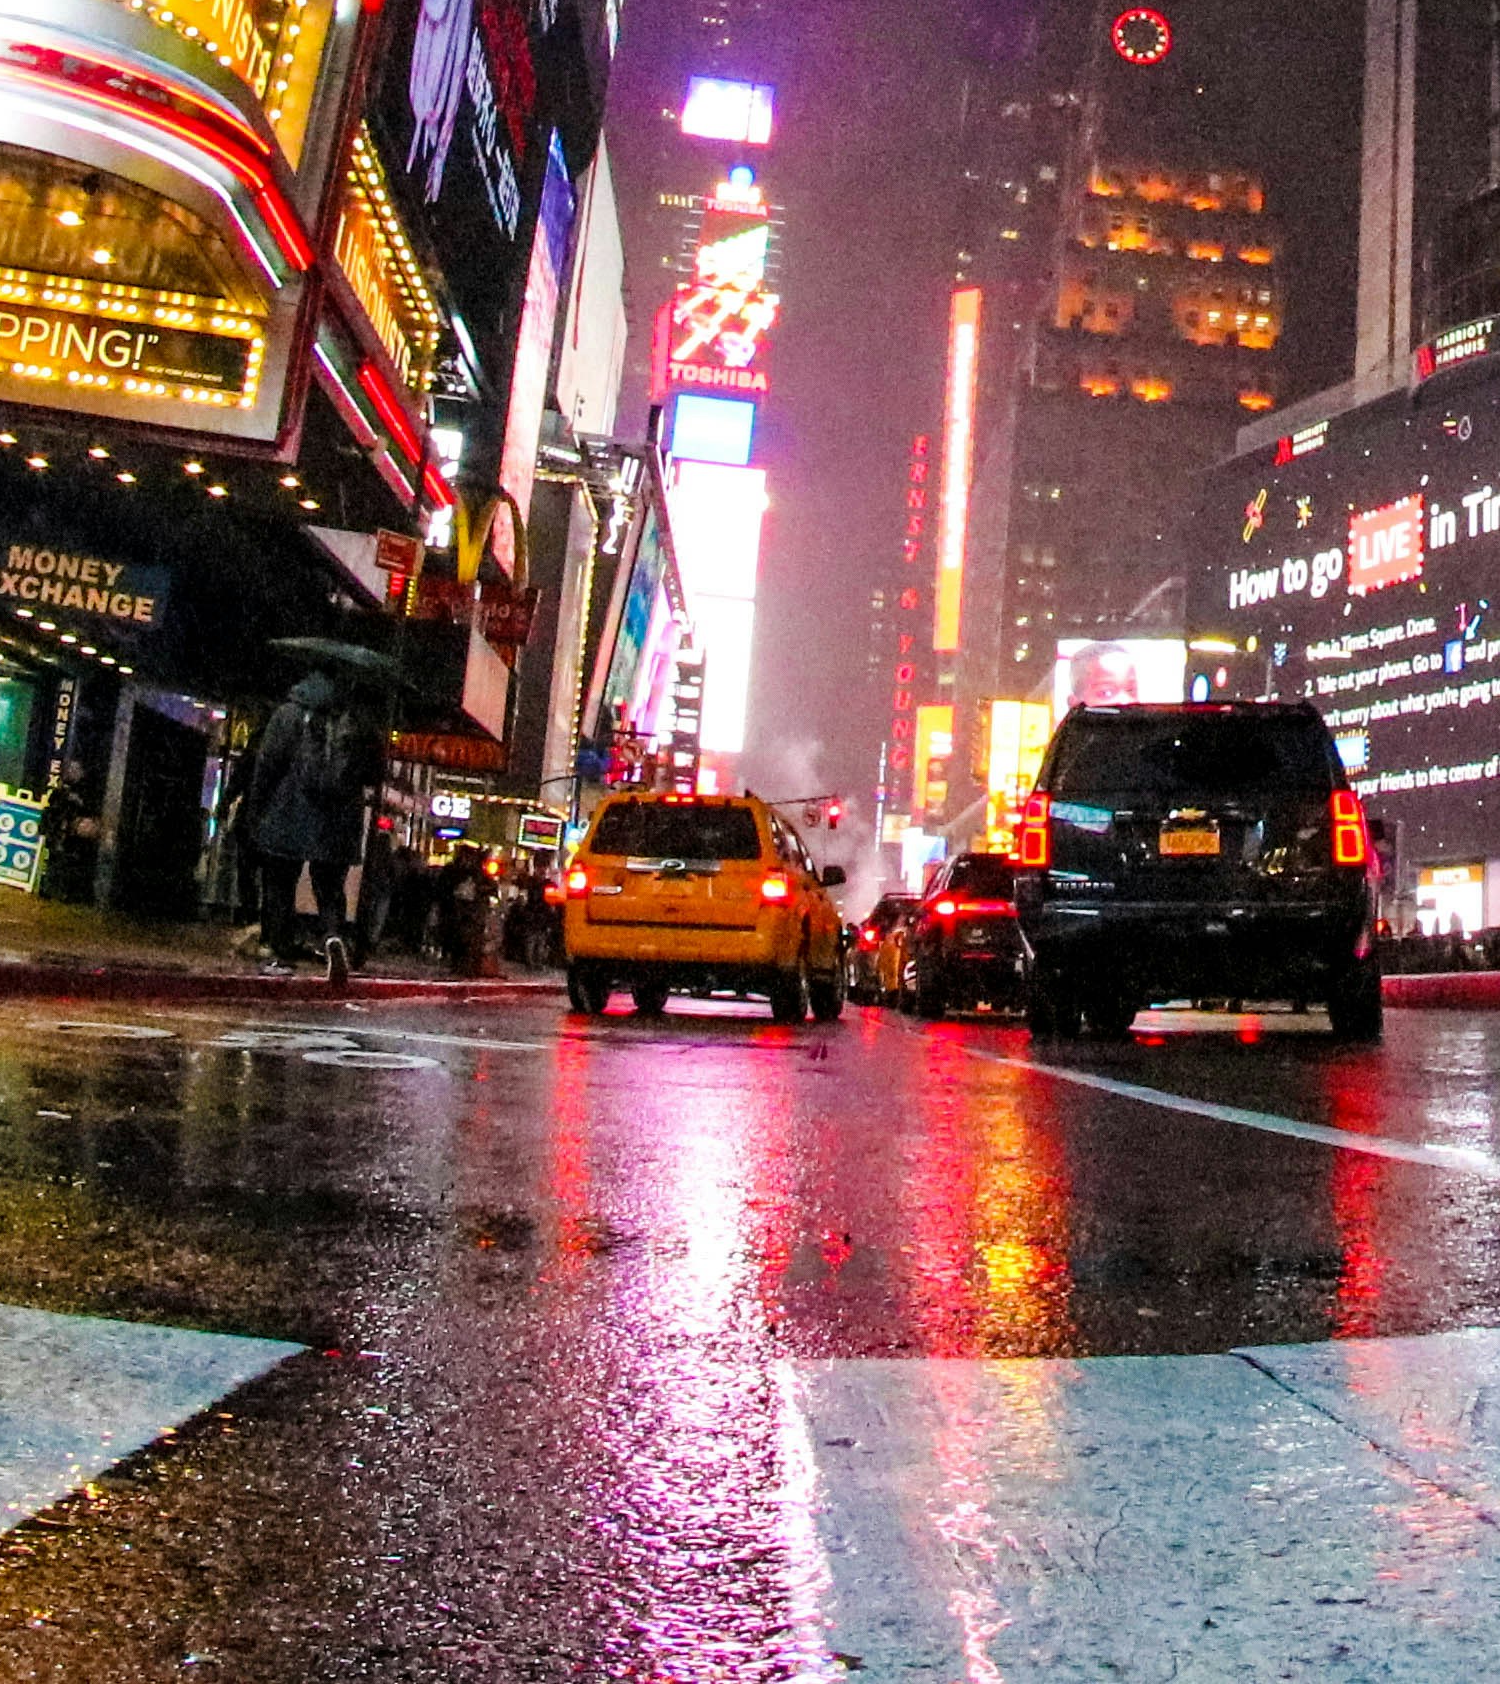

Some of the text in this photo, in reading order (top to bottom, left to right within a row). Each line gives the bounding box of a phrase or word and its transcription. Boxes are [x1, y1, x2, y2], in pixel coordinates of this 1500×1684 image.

[706, 198, 768, 216] TOSHIBA
[1435, 319, 1494, 349] MARRIOTT
[1436, 337, 1487, 365] MARQUIS
[669, 363, 768, 390] TOSHIBA
[6, 544, 124, 585] MONEY
[1229, 565, 1278, 610] How
[1282, 556, 1308, 593] to
[1311, 548, 1343, 599] go
[1358, 521, 1411, 570] LIVE
[1429, 504, 1457, 550] in
[1342, 635, 1369, 652] Times
[1317, 676, 1338, 694] Take
[1338, 673, 1355, 691] out
[1354, 667, 1378, 691] your
[1412, 657, 1429, 673] Go
[1429, 654, 1443, 671] to
[1465, 645, 1486, 662] and
[53, 678, 74, 751] MONEY
[1341, 707, 1371, 728] worry
[1370, 699, 1400, 719] about
[1400, 693, 1426, 714] what
[1425, 687, 1460, 715] you're
[1459, 683, 1492, 708] going
[1356, 779, 1378, 800] your
[1380, 772, 1414, 792] friends
[1416, 770, 1429, 787] to
[1429, 764, 1448, 785] the
[1448, 761, 1484, 784] center
[1484, 758, 1499, 779] of
